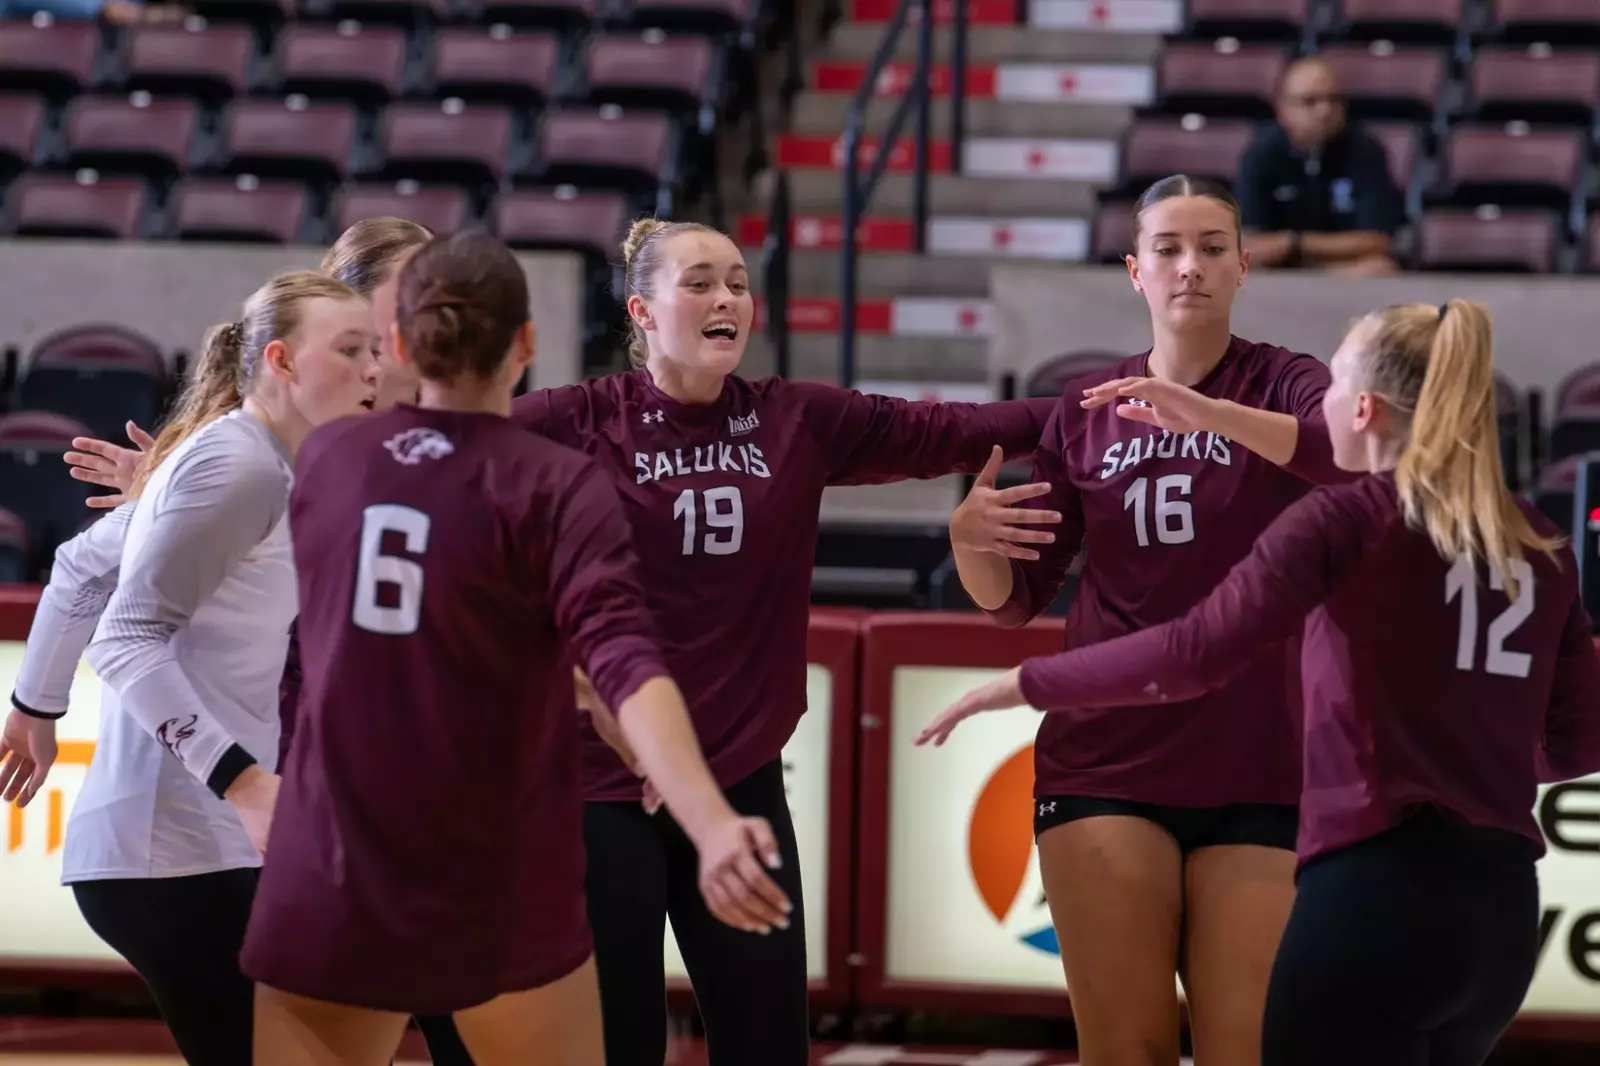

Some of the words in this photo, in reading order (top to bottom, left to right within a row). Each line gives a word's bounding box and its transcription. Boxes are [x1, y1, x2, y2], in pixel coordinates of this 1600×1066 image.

[634, 441, 772, 485] SALUKIS
[673, 486, 744, 556] 19
[1124, 474, 1195, 547] 16
[352, 504, 431, 635] 6
[1445, 552, 1535, 678] 12
